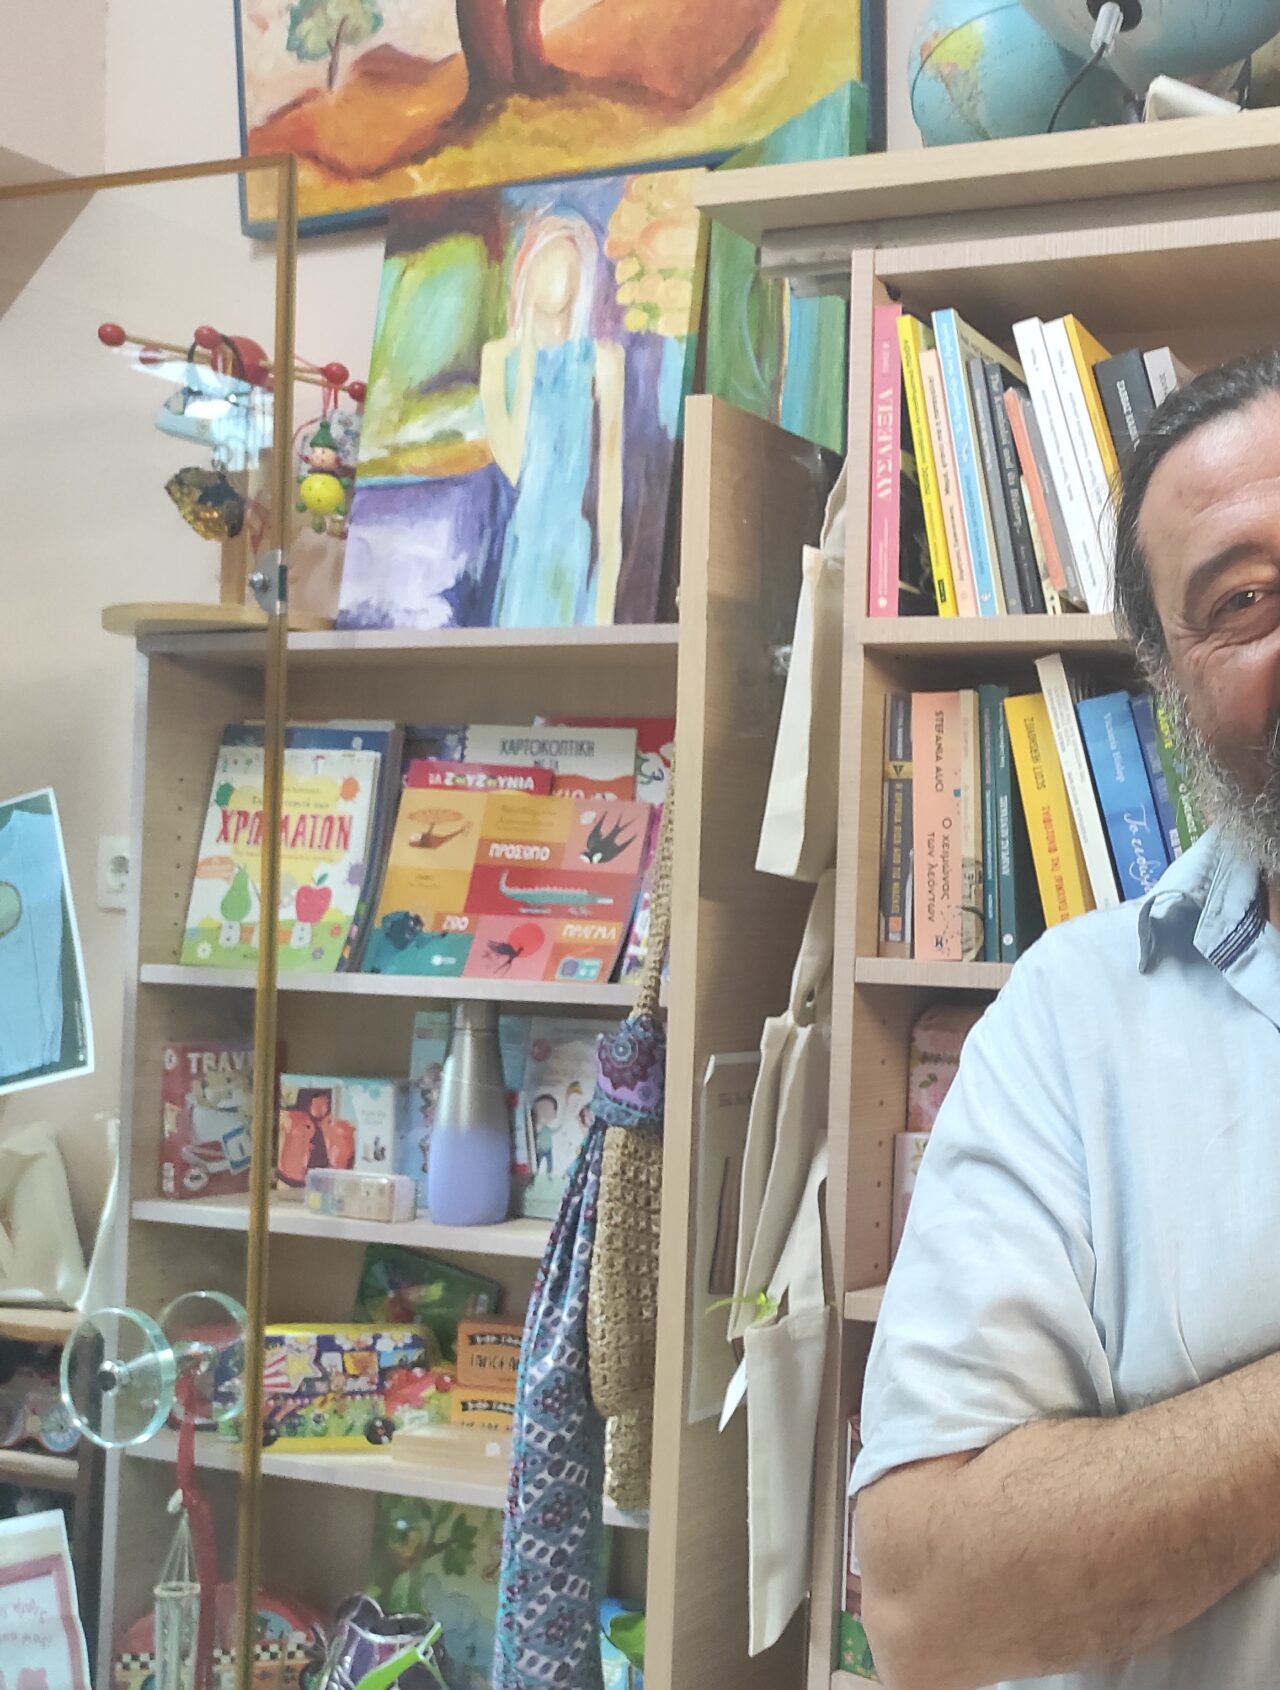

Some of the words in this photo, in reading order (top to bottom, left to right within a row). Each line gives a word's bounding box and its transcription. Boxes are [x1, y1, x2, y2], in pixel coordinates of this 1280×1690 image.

[934, 710, 945, 762] STEFANIA
[500, 737, 595, 758] ΚΑΡΤΟΚΟΠΤΙΚΗ
[489, 843, 551, 861] ΠΡΟΣΩΠΟ
[926, 832, 936, 860] των
[562, 923, 617, 941] ΠΡΑΓΜΑ
